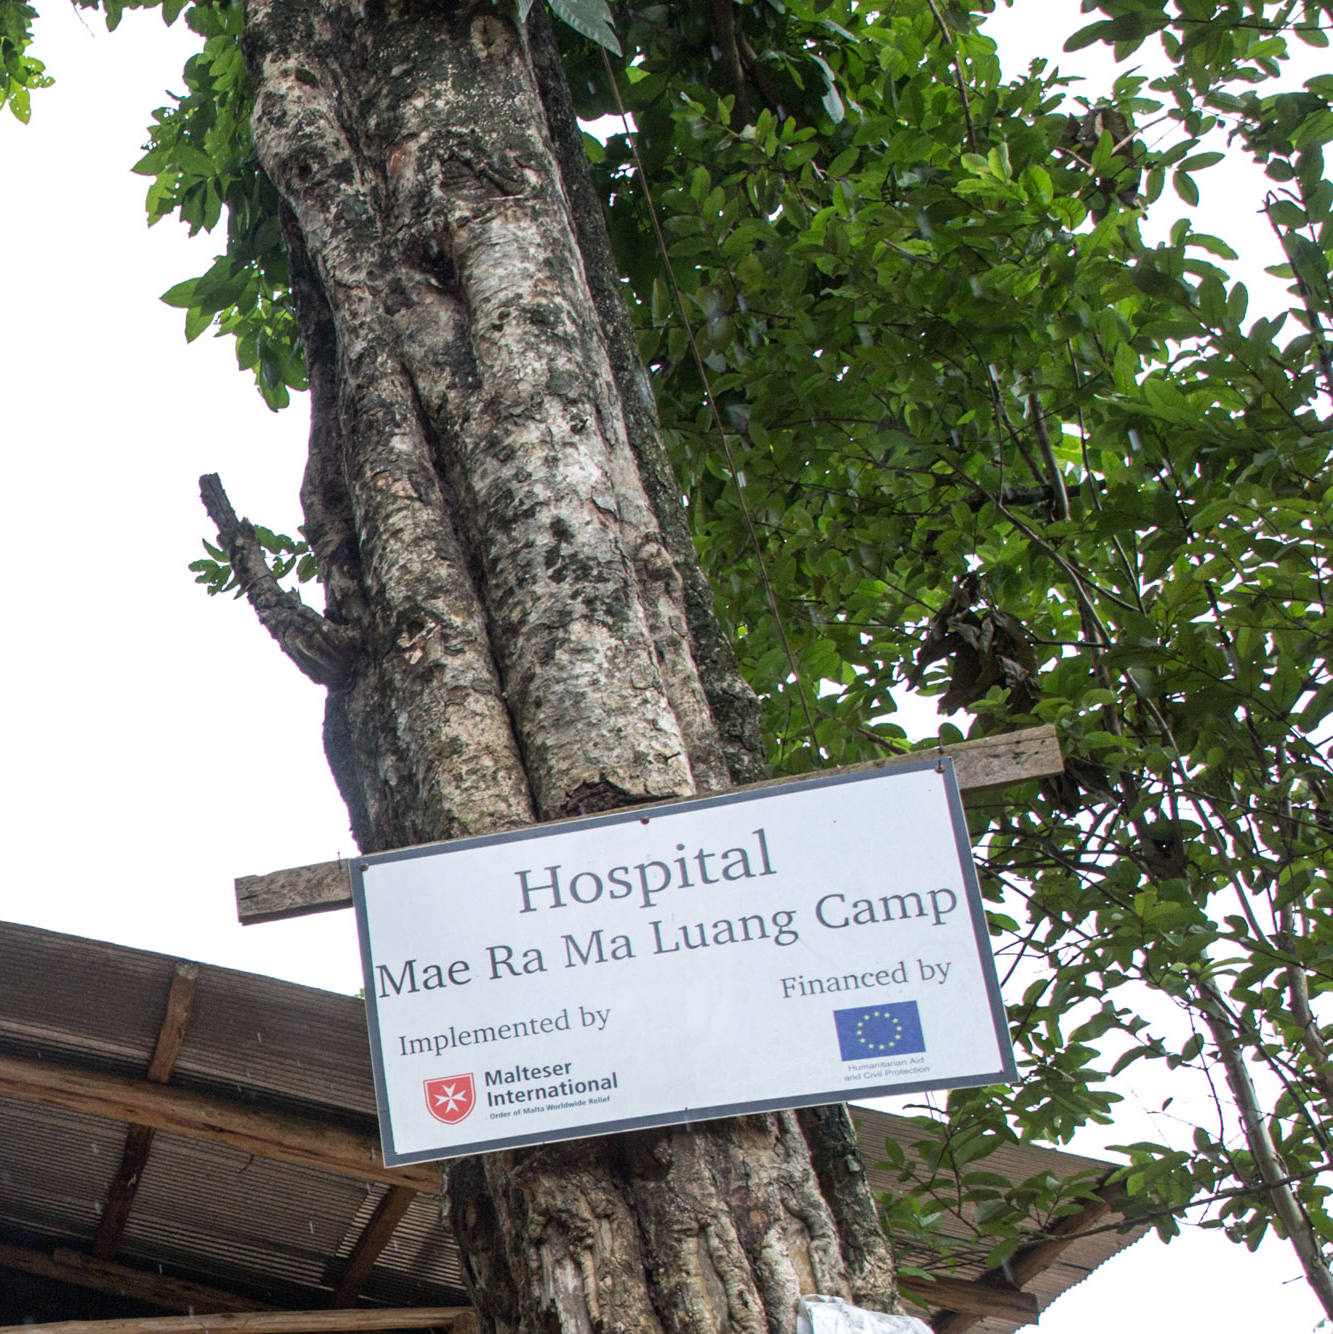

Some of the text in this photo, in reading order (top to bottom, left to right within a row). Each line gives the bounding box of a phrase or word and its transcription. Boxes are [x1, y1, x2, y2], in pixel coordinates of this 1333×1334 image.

[514, 828, 778, 914] Hospital
[375, 886, 958, 999] Mae Ra Ma Luang Camp
[779, 958, 952, 999] Financed by
[398, 1006, 612, 1057] Implemented by
[484, 1061, 573, 1088] Malteser
[844, 1066, 930, 1082] and Civil Protection
[847, 1057, 925, 1072] Humanitarian Aid
[487, 1072, 619, 1108] International
[489, 1110, 512, 1120] Order
[523, 1106, 545, 1115] Malta
[546, 1099, 587, 1112] Worldwide
[588, 1095, 611, 1105] Relief
